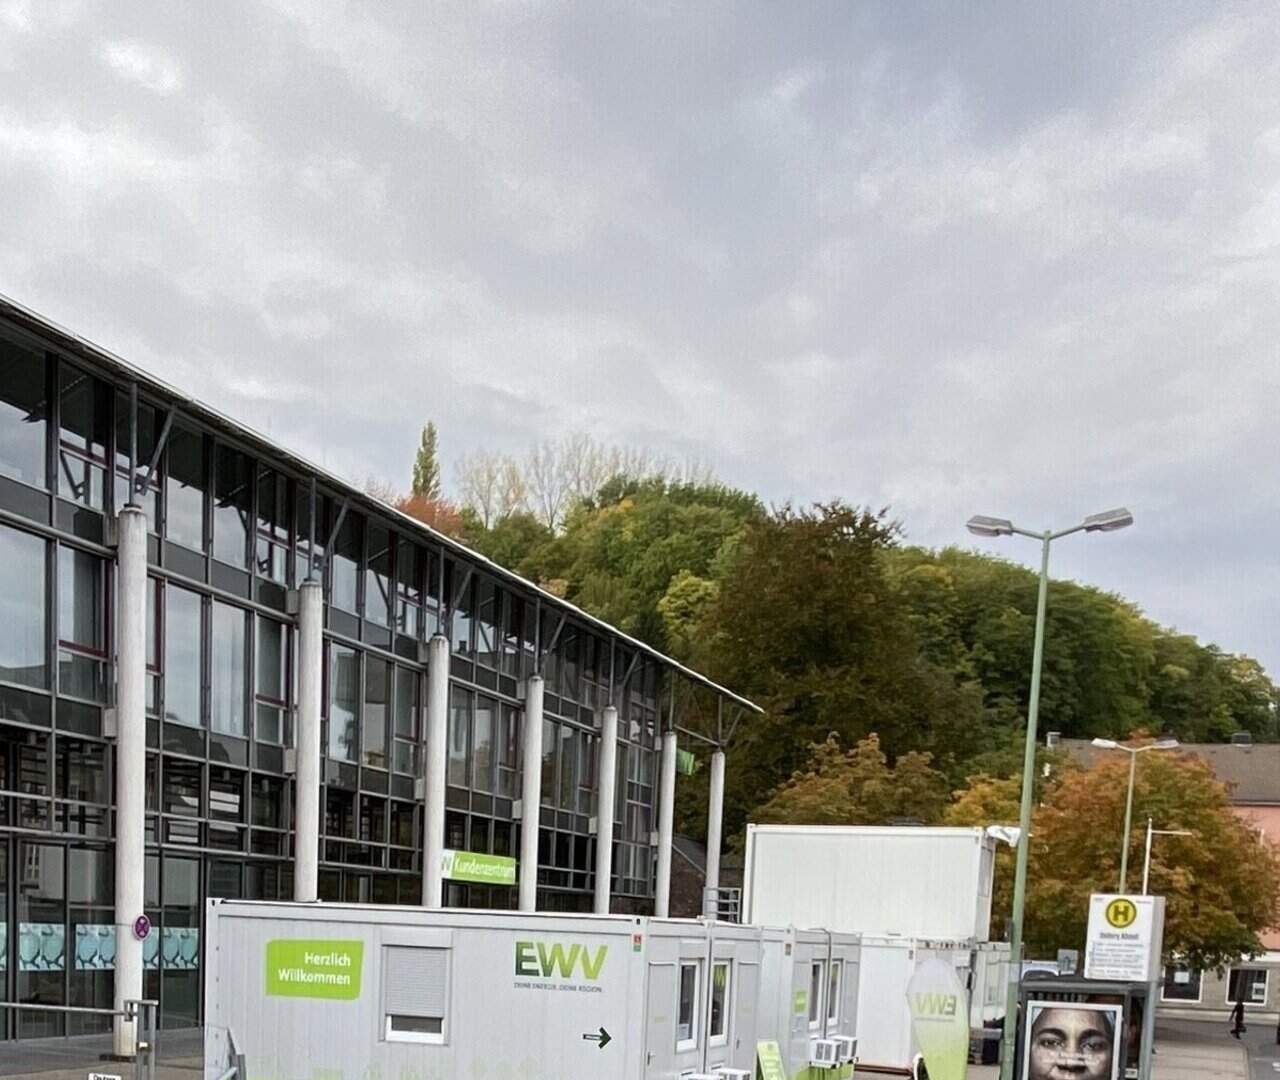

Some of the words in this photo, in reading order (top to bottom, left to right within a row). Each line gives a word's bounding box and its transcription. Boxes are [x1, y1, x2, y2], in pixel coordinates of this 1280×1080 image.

[304, 951, 352, 968] Herzlich
[514, 941, 609, 980] EWV
[277, 969, 352, 985] Willkommen
